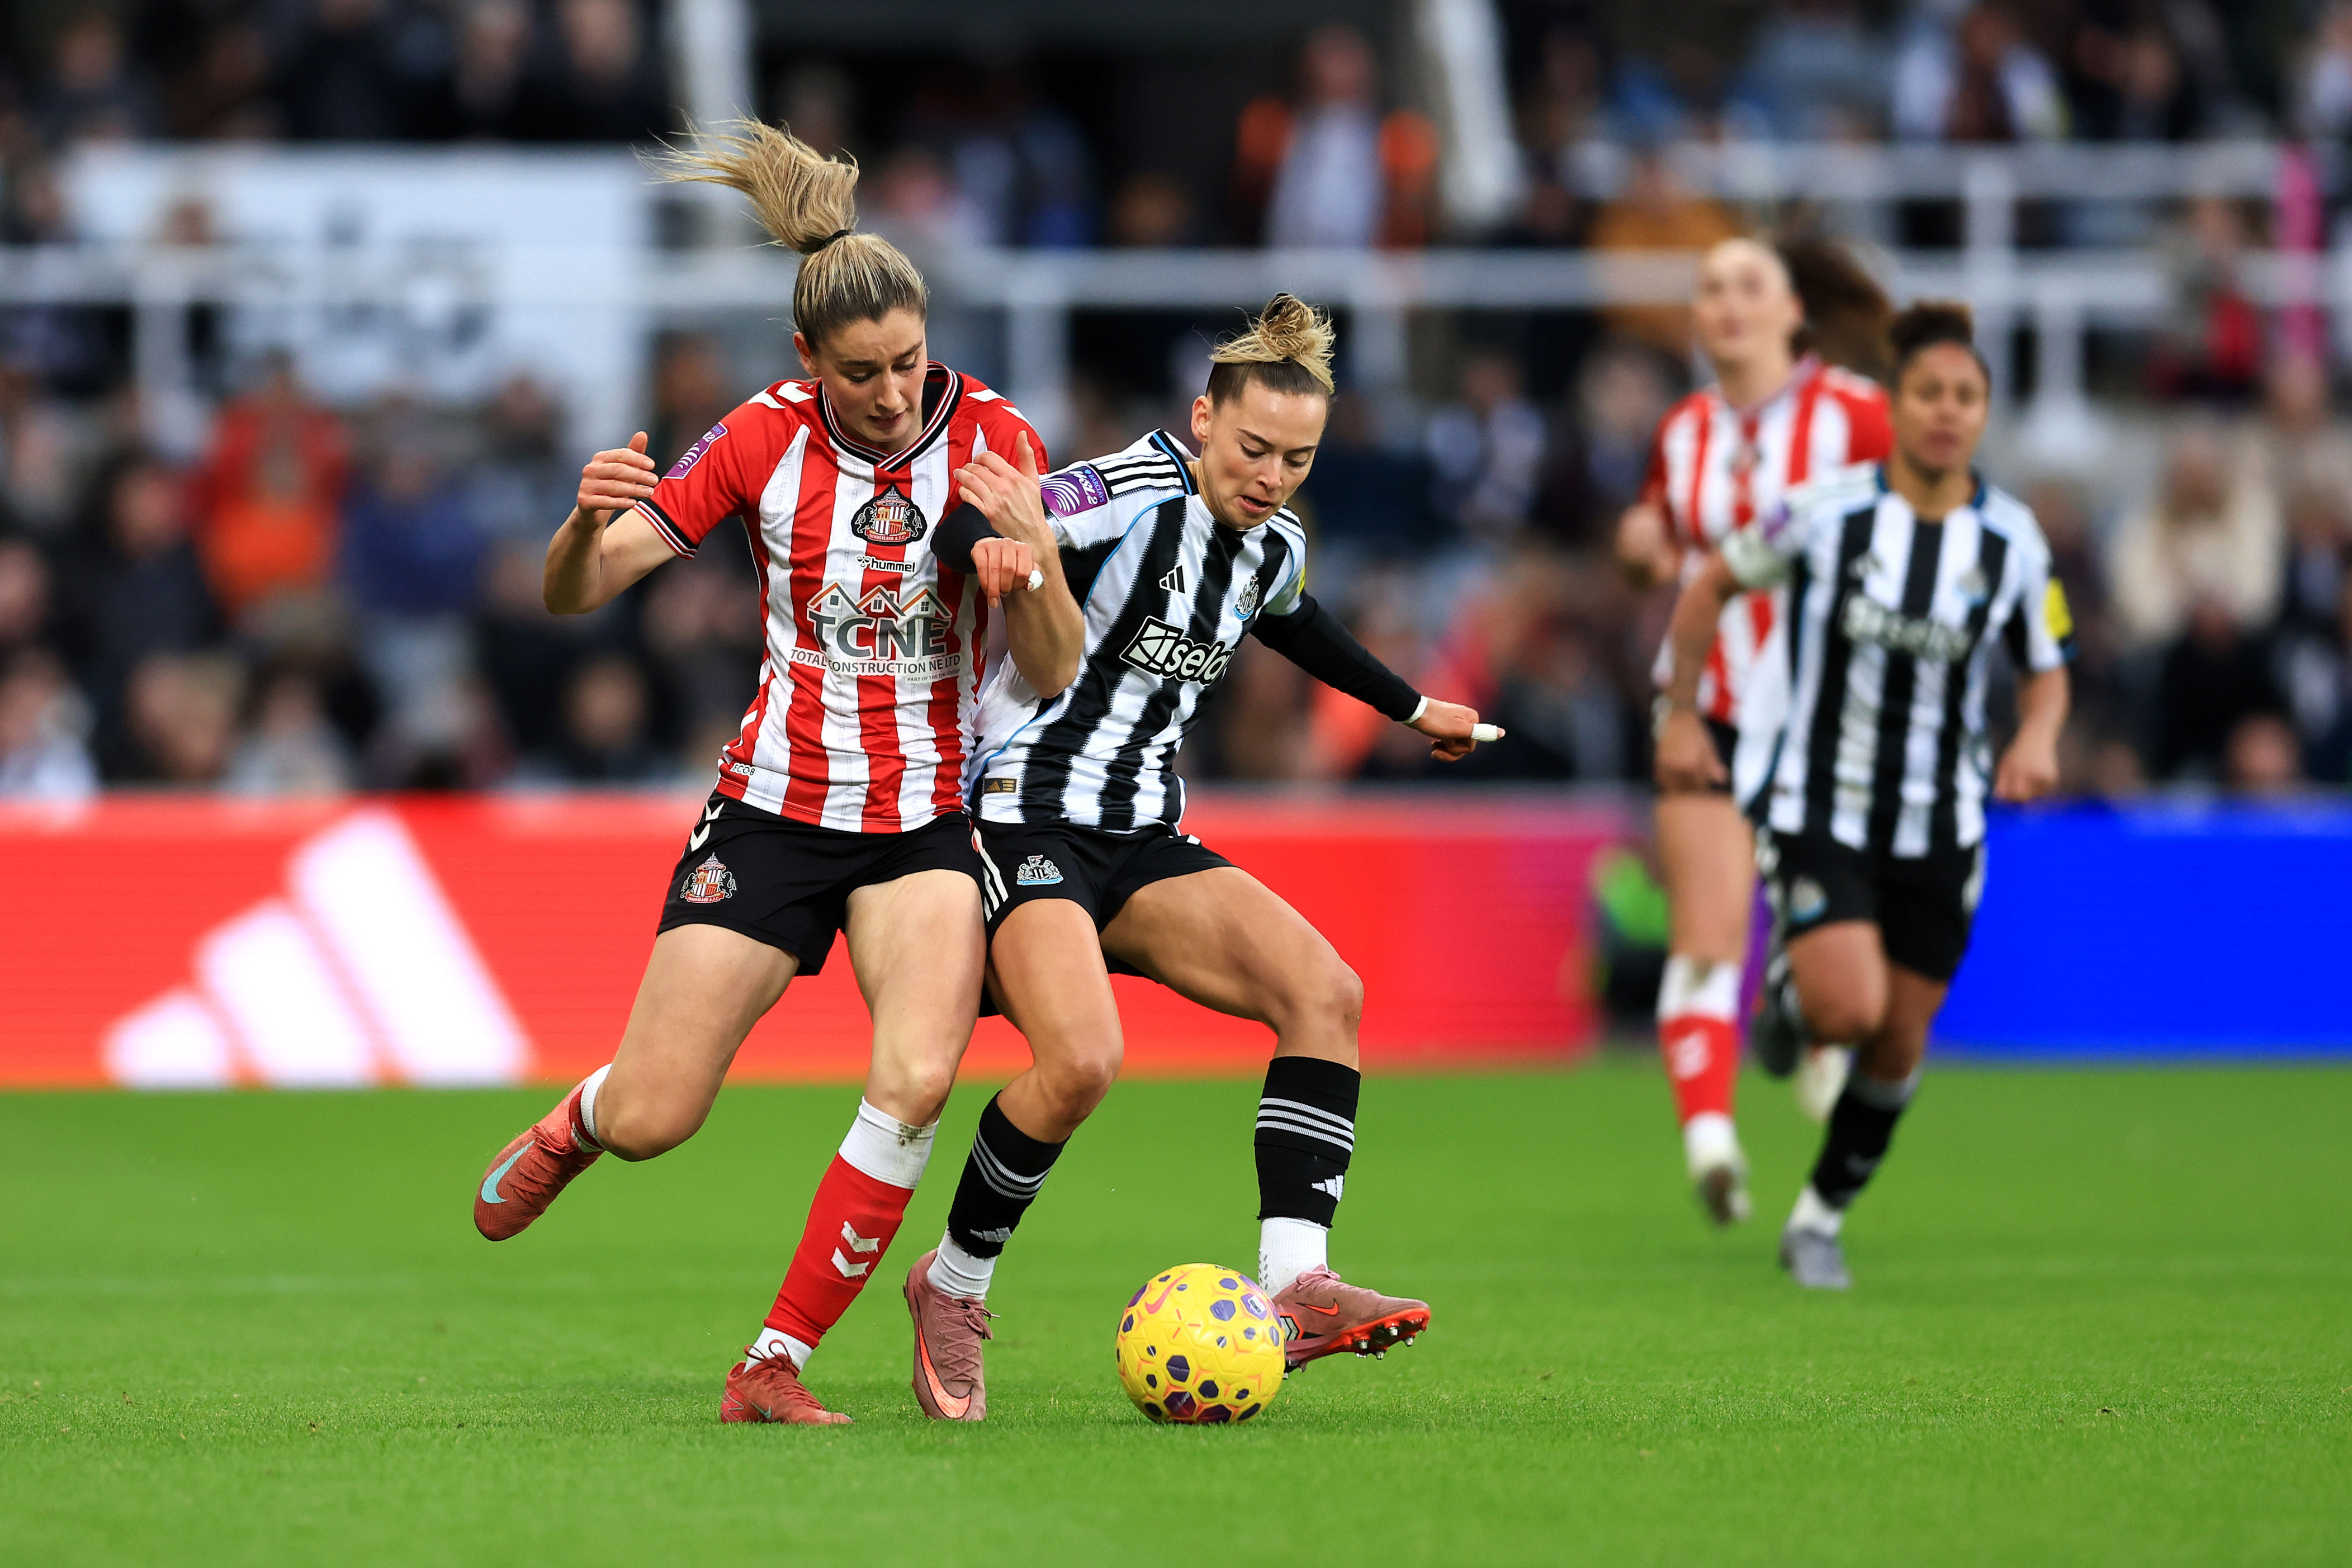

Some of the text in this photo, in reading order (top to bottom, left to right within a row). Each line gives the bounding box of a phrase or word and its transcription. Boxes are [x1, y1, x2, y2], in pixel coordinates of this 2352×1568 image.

[1089, 473, 1105, 503] BARCLAYS
[870, 558, 916, 572] hummel
[808, 611, 949, 657] TCNE
[791, 648, 960, 674] TOTAL CONSTRUCTION NE LTD
[732, 764, 755, 776] ECO8
